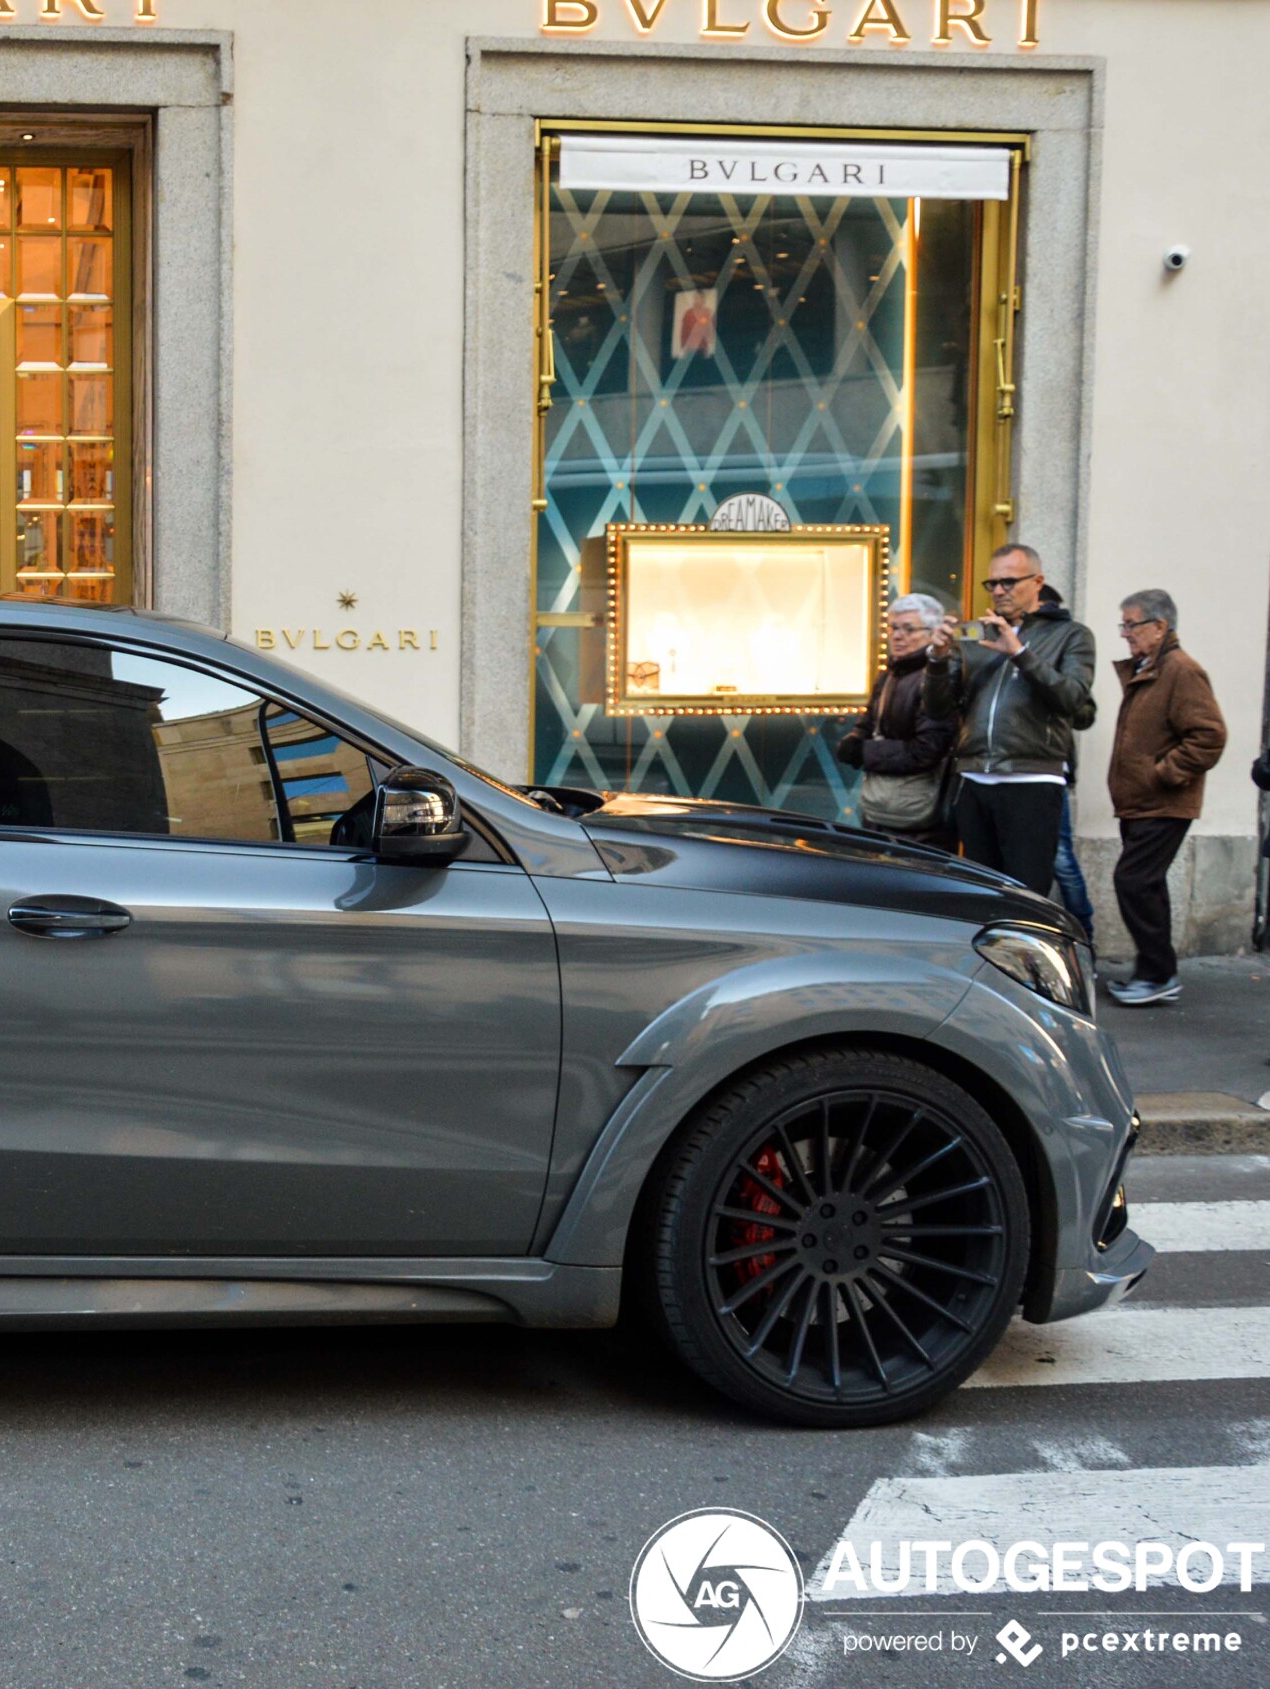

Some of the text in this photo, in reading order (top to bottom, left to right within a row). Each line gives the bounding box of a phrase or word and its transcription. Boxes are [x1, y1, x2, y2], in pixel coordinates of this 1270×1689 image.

[541, 0, 1039, 43] BVLGARI
[688, 158, 886, 185] BVLGARI
[713, 495, 789, 532] DREAMAKER
[255, 629, 438, 650] BVLGARI
